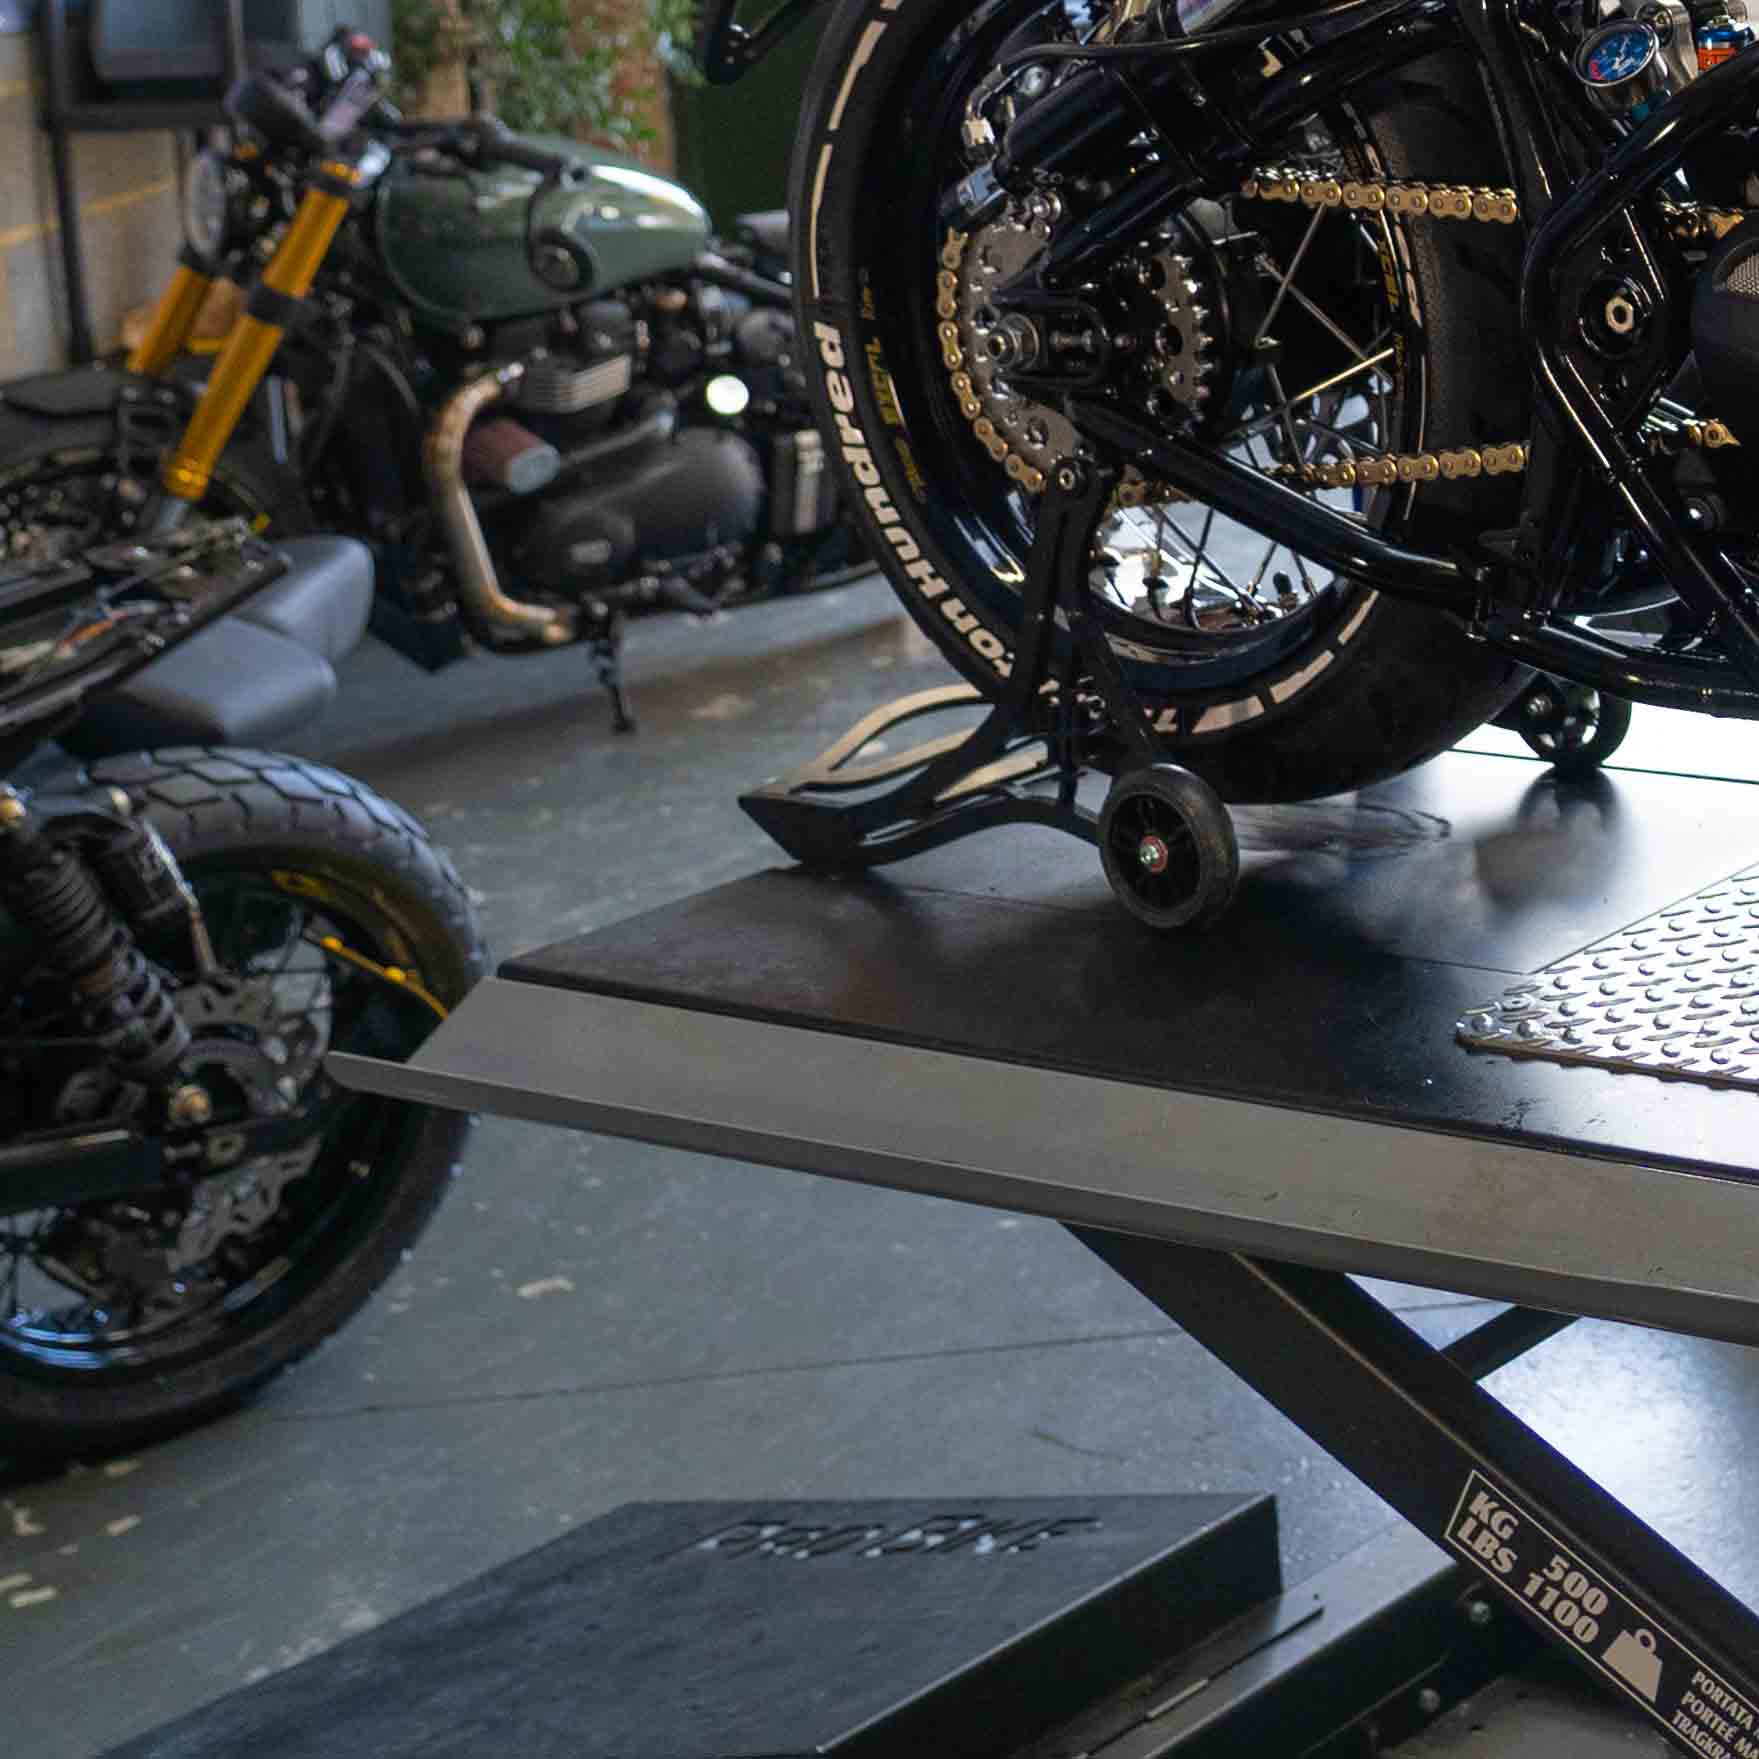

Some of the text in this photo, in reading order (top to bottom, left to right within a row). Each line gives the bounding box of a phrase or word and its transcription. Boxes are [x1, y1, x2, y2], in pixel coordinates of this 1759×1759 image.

[813, 320, 950, 599] Hundred
[1457, 1522, 1600, 1645] LBS 1100
[1468, 1491, 1610, 1616] KG 500
[1691, 1671, 1754, 1730] PORTATA
